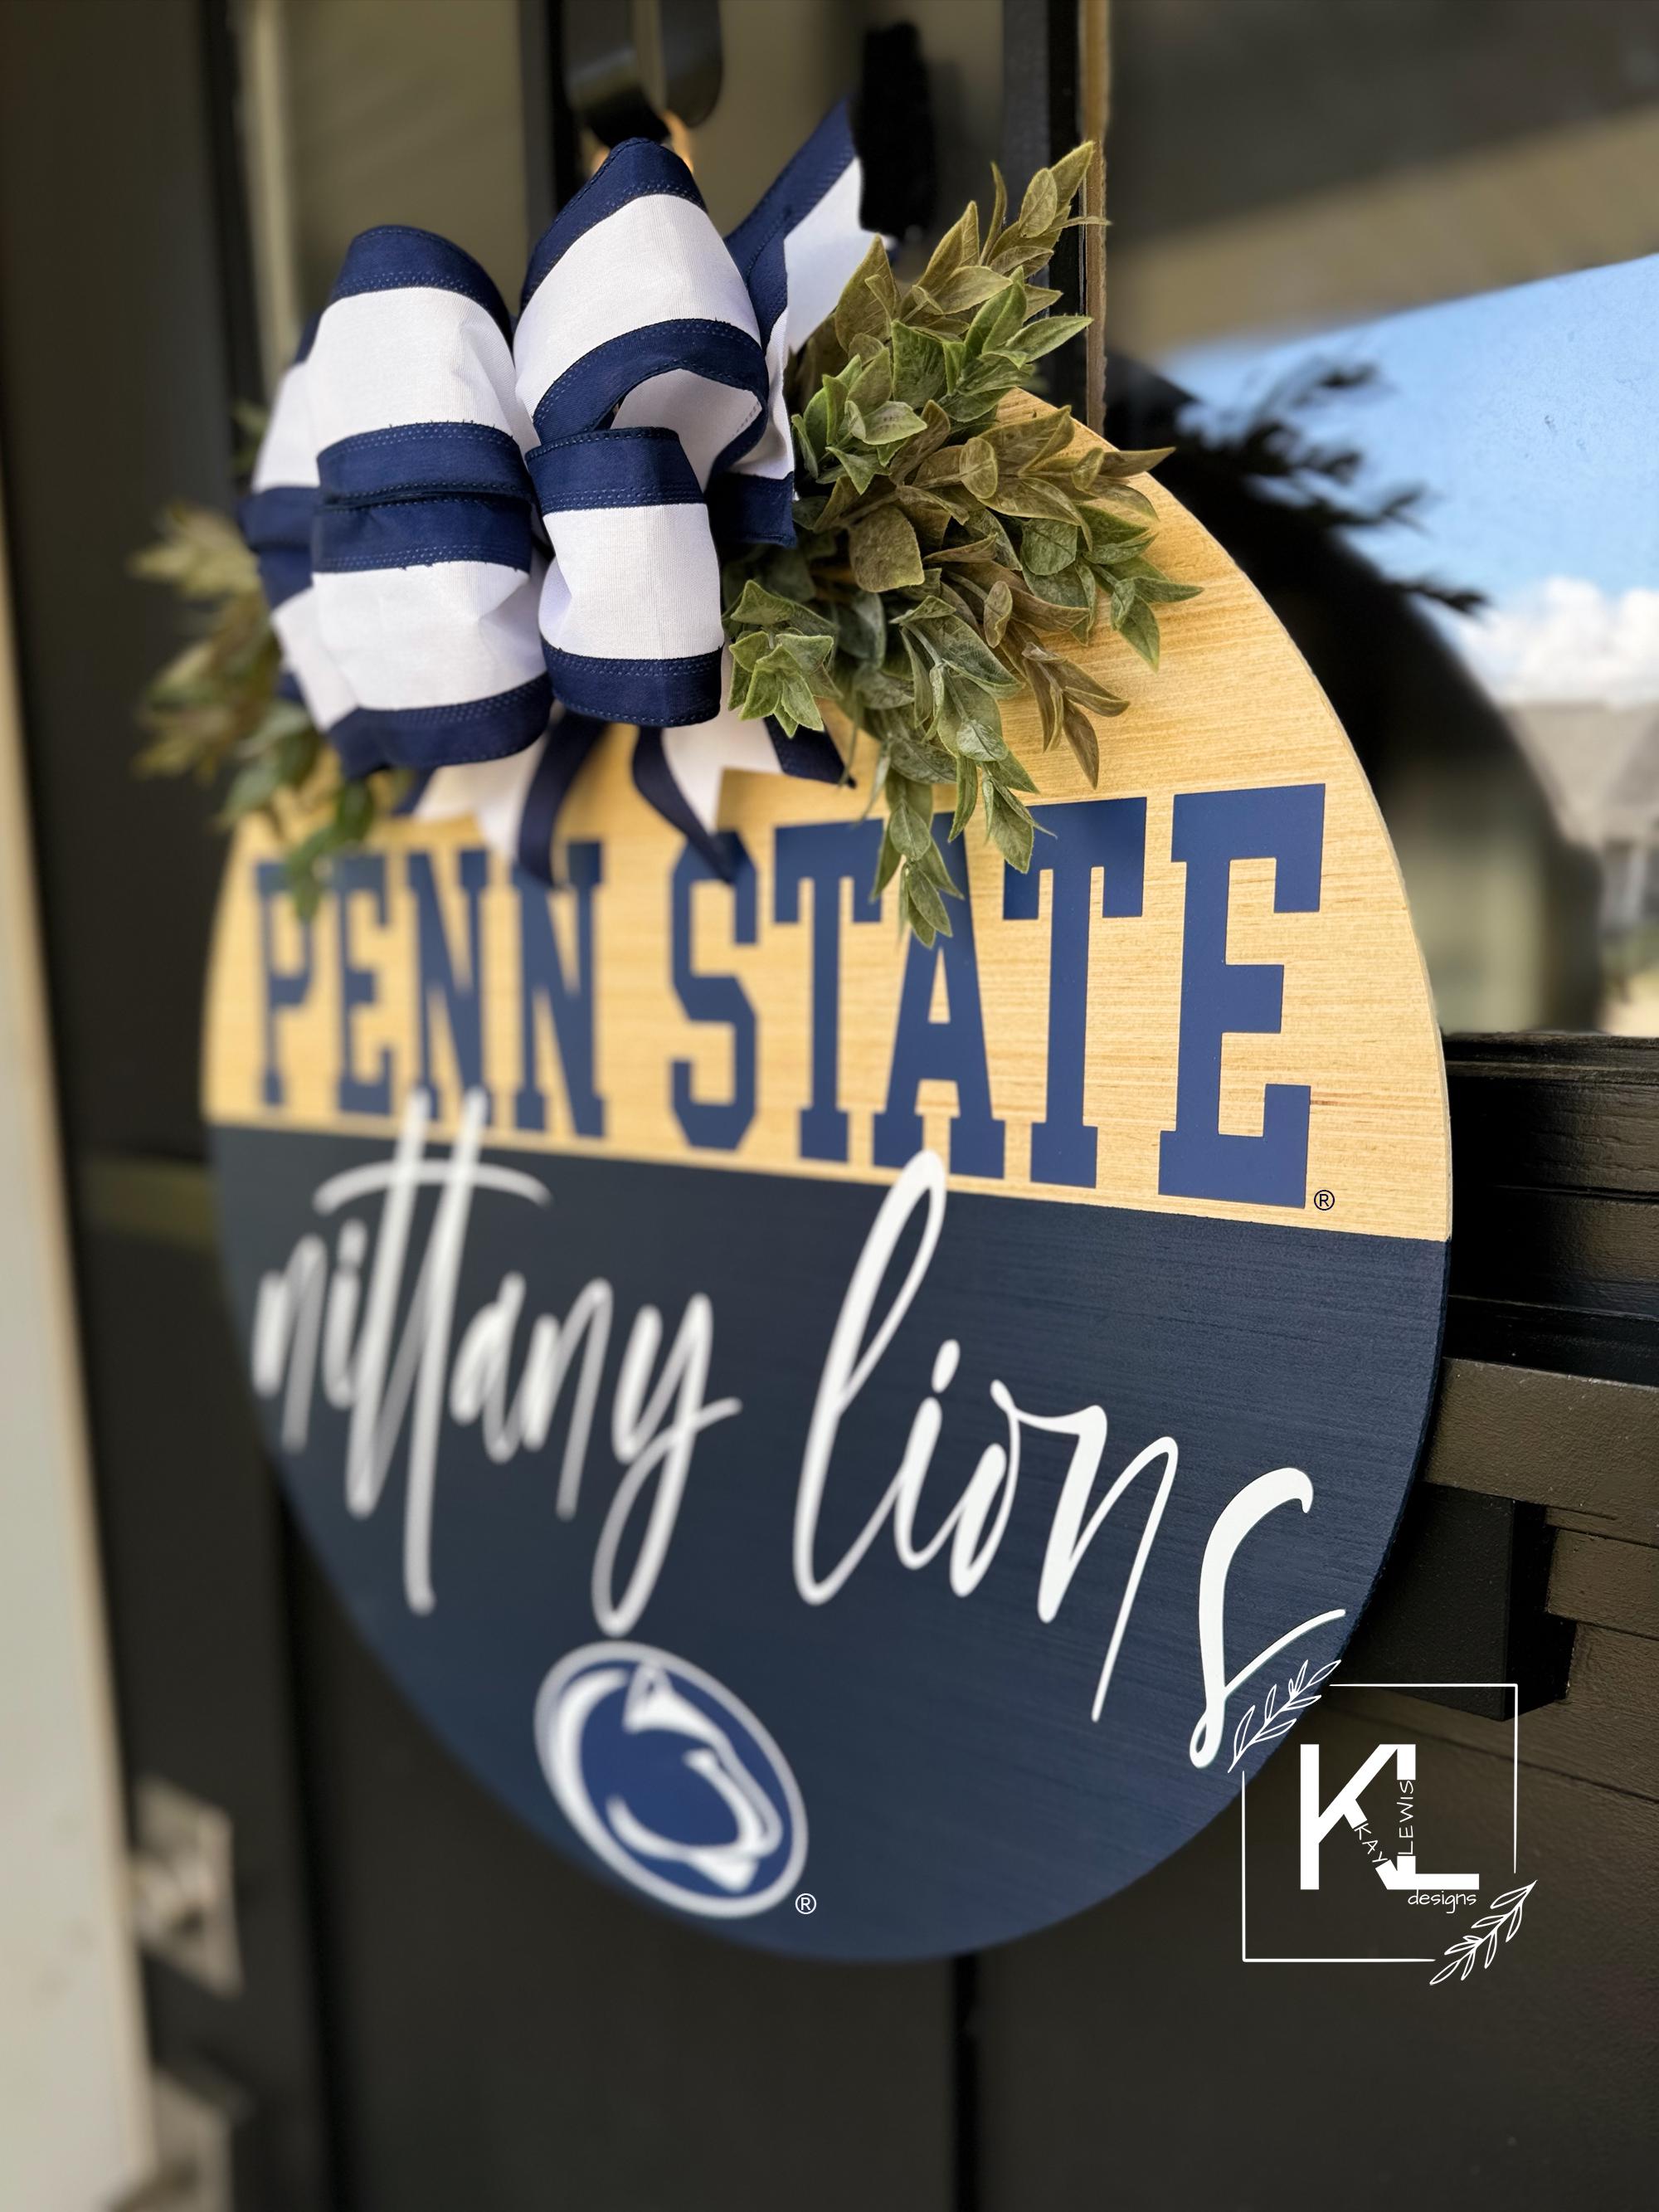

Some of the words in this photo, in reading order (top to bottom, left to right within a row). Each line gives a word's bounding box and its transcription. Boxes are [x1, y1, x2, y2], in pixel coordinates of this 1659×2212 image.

[255, 840, 606, 1139] PENN
[669, 783, 1326, 1209] STATE
[252, 1084, 742, 1638] nittany
[793, 1149, 1346, 1769] lions
